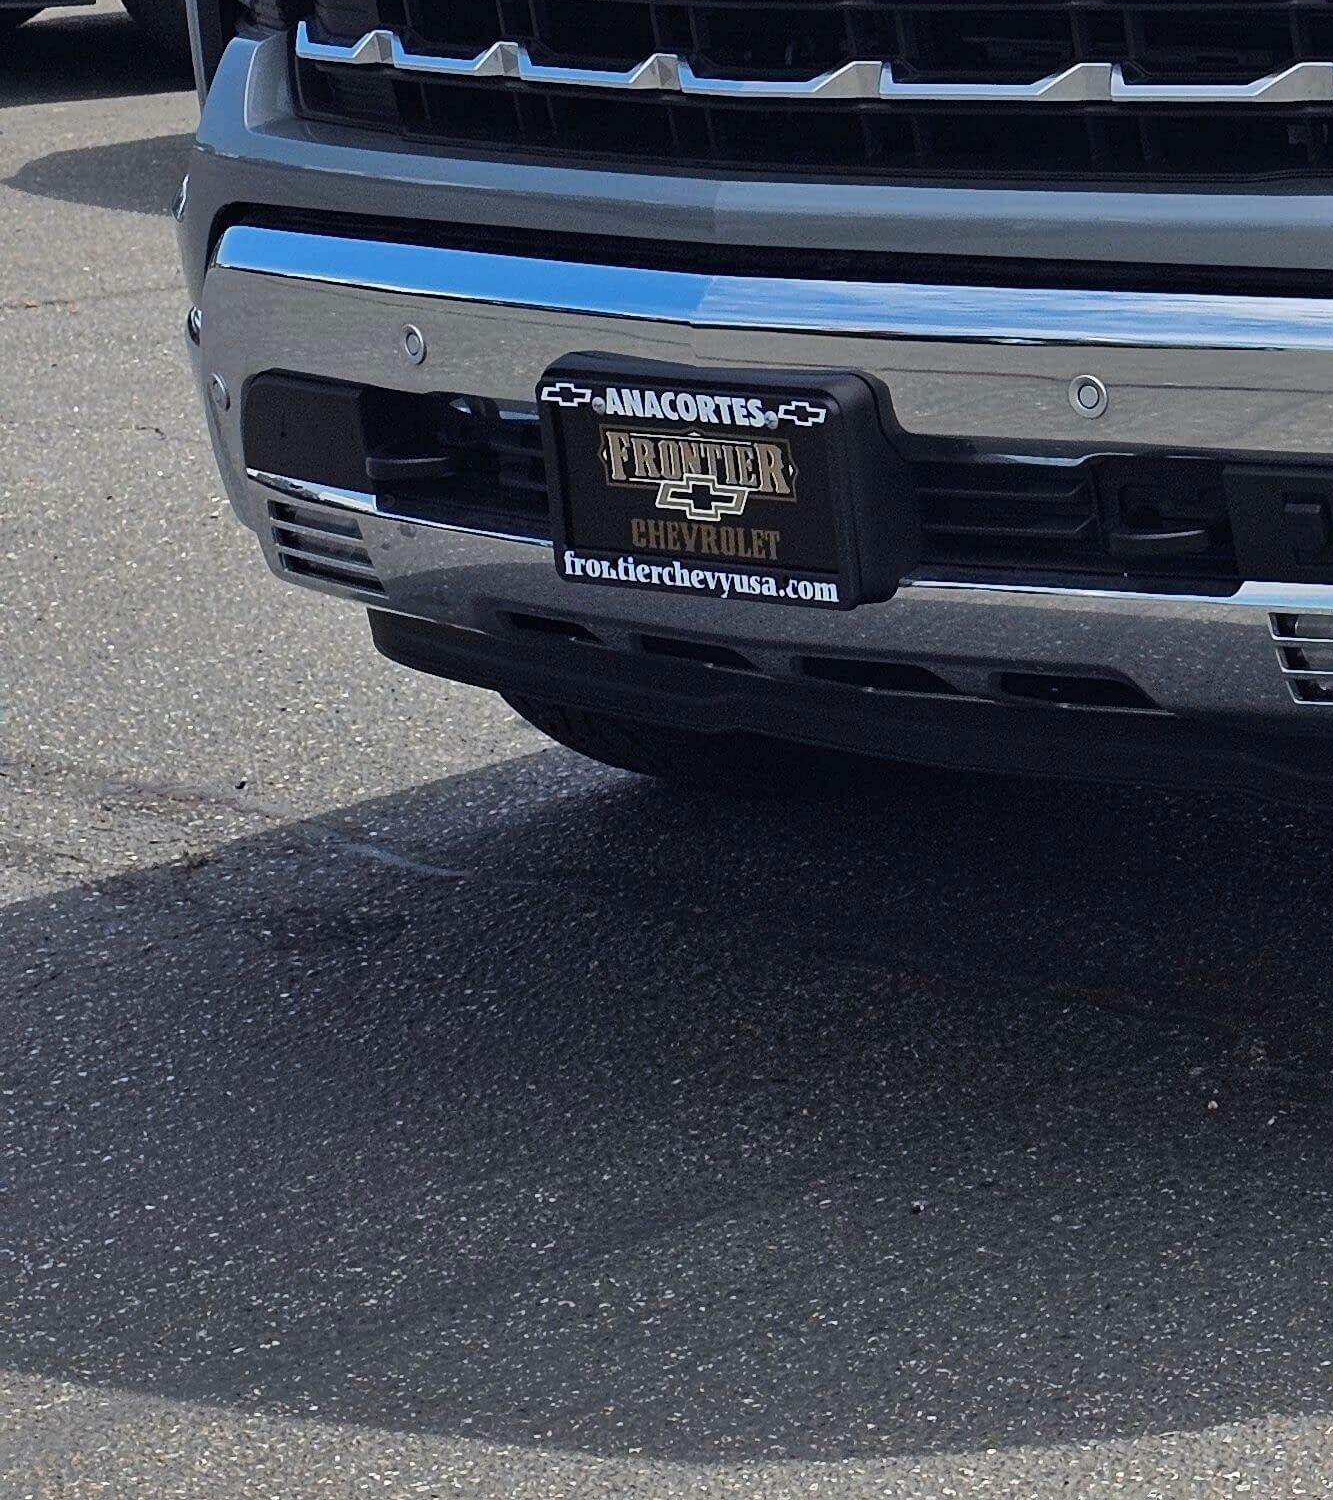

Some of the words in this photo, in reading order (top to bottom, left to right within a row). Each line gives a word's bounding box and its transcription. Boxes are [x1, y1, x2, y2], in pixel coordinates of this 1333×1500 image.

[604, 387, 765, 427] ANACORTES
[605, 430, 791, 494] FRONTIER
[630, 517, 780, 560] CHEVROLET
[563, 550, 839, 602] frontierchevyusa.com
